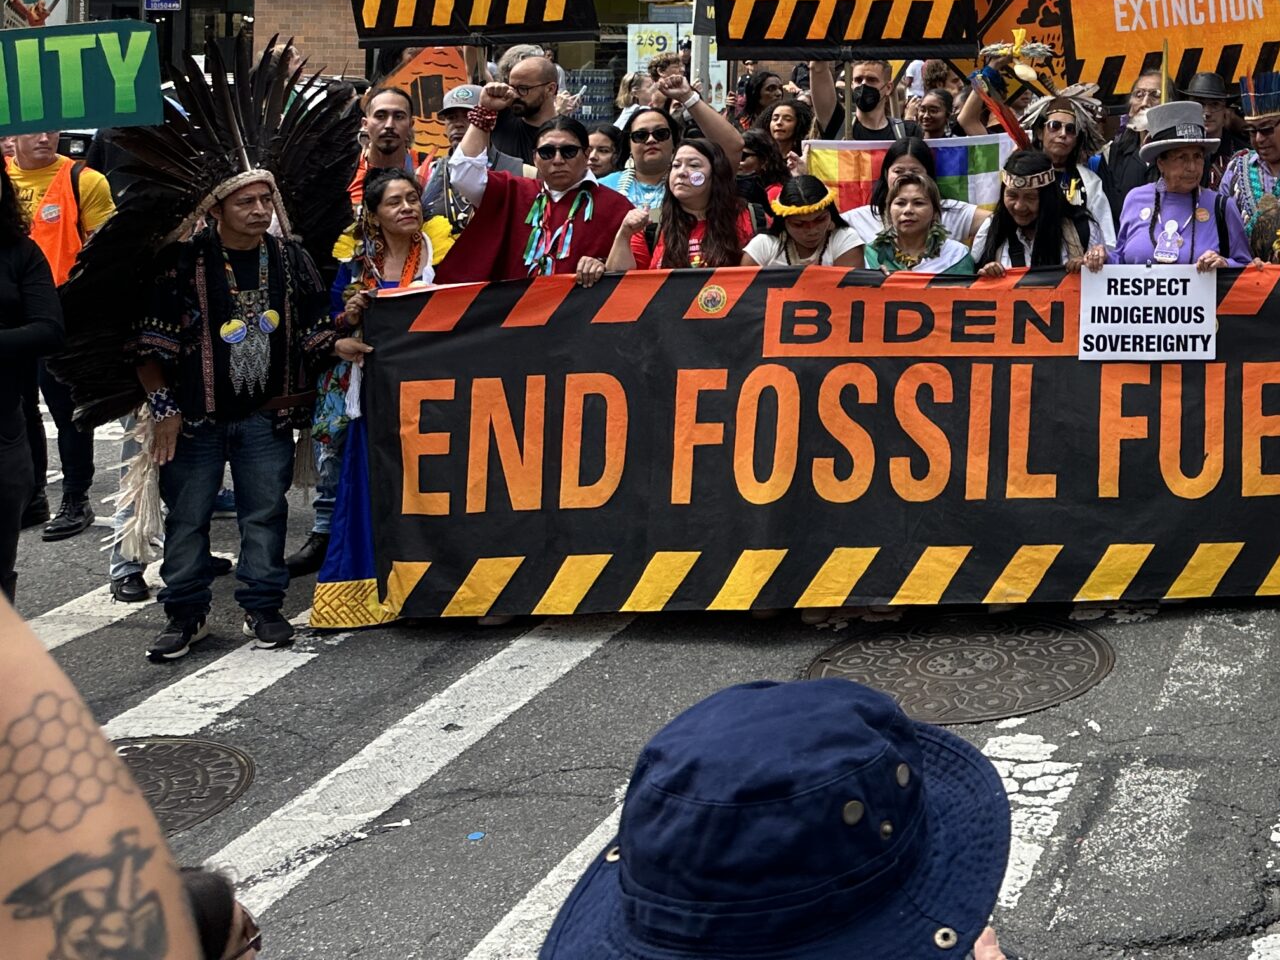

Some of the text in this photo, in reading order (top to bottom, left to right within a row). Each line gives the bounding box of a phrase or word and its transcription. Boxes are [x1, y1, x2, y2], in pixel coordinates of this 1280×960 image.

[0, 31, 151, 126] ITY
[1107, 278, 1191, 296] RESPECT
[779, 300, 1064, 344] BIDEN
[1091, 306, 1205, 324] INDIGENOUS
[1083, 334, 1212, 352] SOVEREIGNTY
[400, 373, 629, 515] END
[671, 362, 1057, 506] FOSSIL
